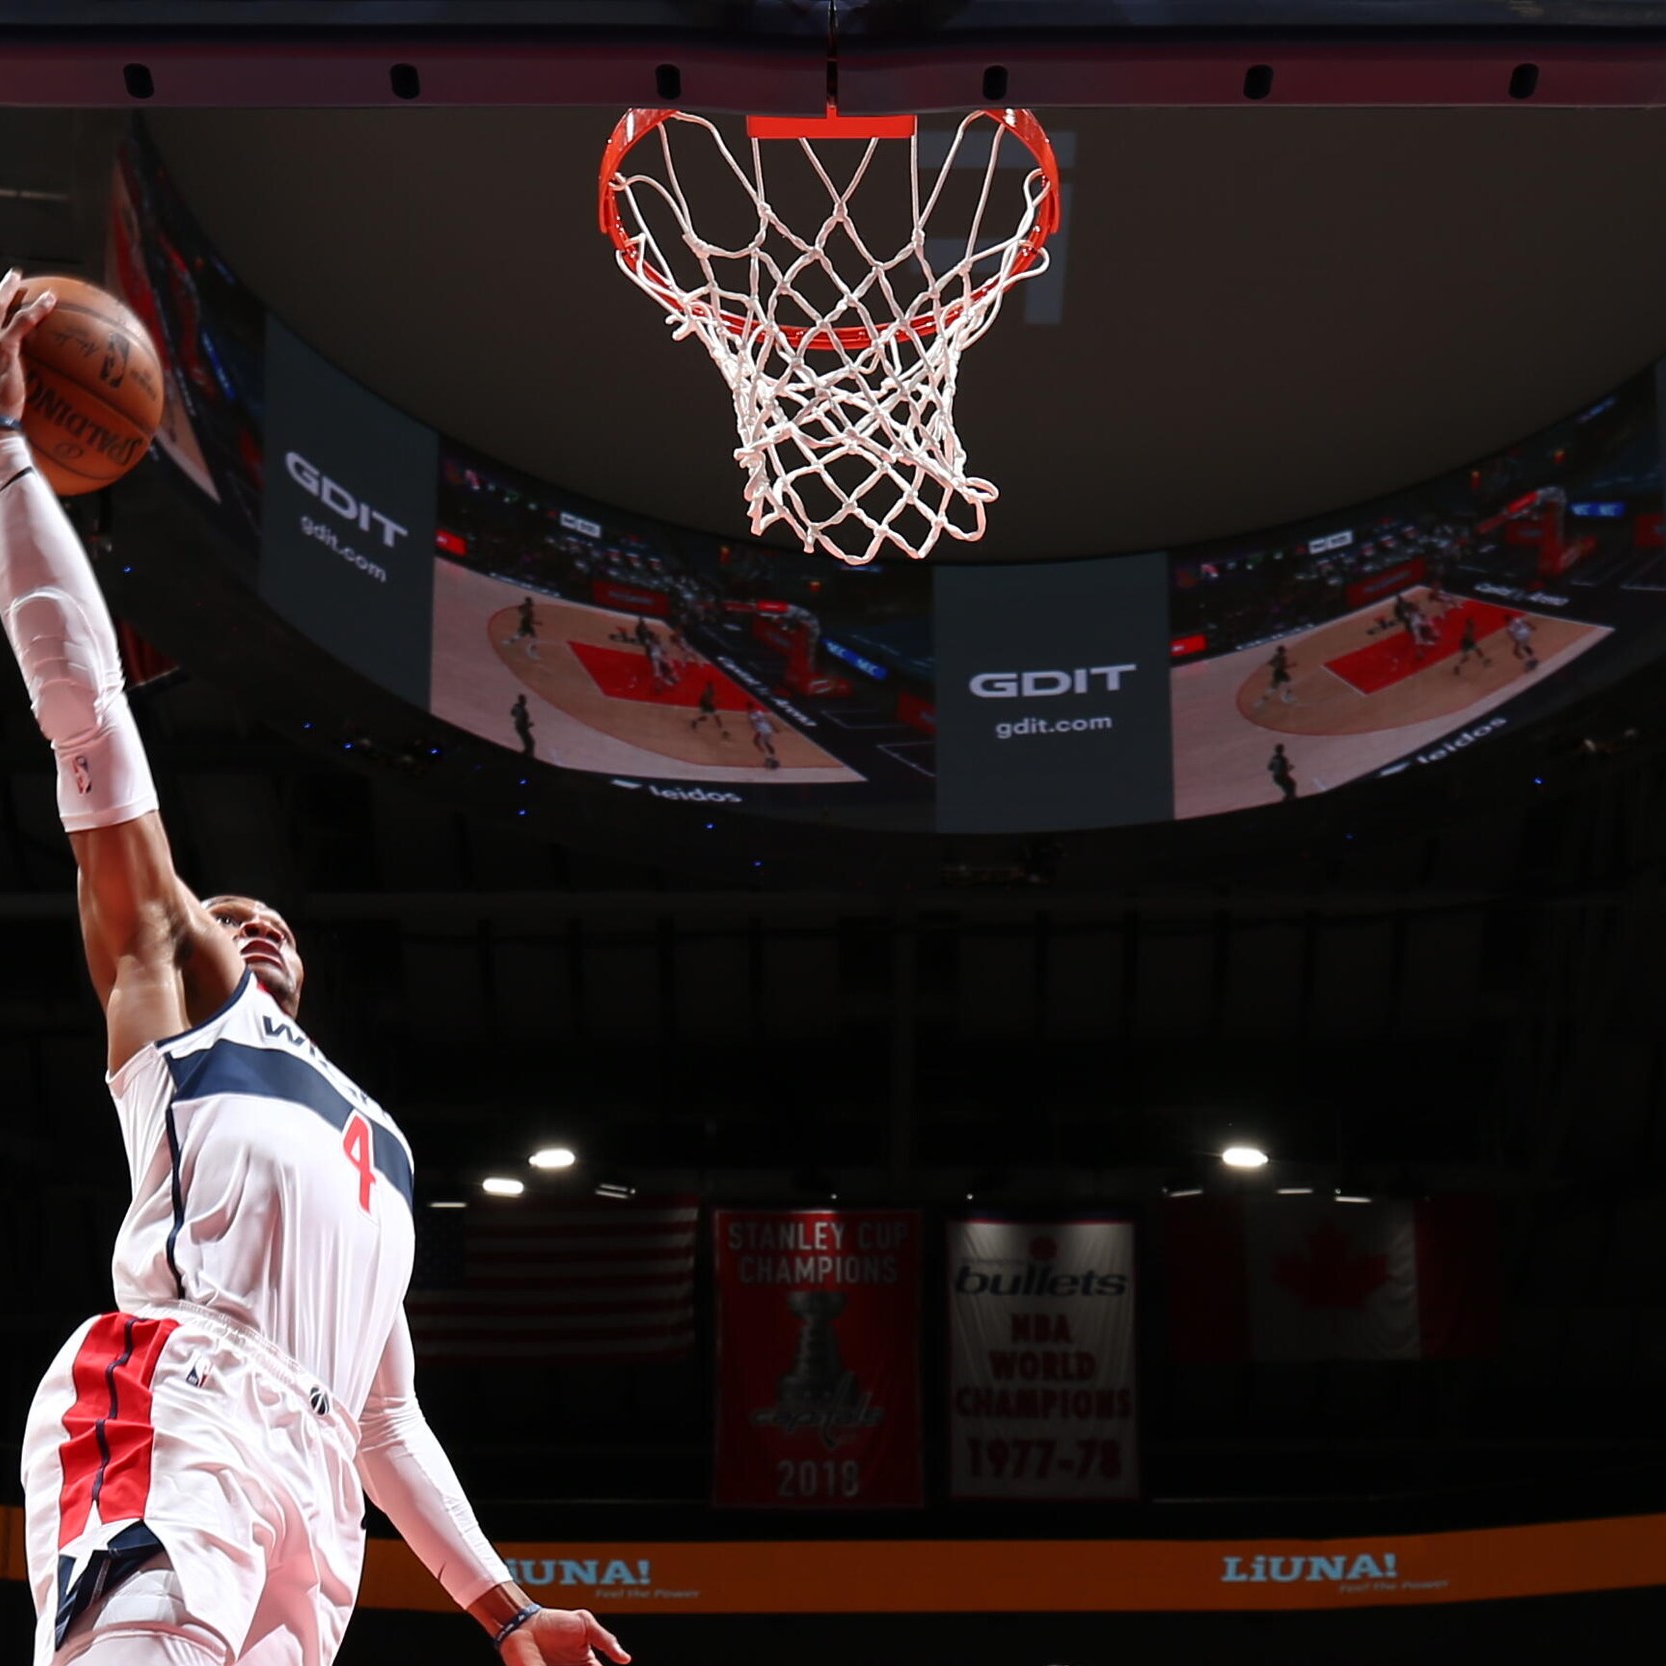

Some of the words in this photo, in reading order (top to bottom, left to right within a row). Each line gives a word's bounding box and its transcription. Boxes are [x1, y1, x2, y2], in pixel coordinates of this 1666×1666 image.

[284, 450, 409, 548] GDIT
[300, 515, 388, 584] gdit.com
[968, 664, 1137, 699] GDIT
[995, 713, 1114, 739] gdit.com
[648, 784, 742, 803] leidos
[341, 1113, 377, 1217] 4
[727, 1222, 846, 1252] STANLEY
[857, 1222, 910, 1251] CUP
[739, 1255, 899, 1284] CHAMPIONS
[955, 1263, 1127, 1297] bullets
[1010, 1313, 1072, 1344] NBA
[988, 1351, 1097, 1382] WORLD
[956, 1386, 1132, 1419] CHAMPIONS
[967, 1437, 1122, 1480] 1977-78
[776, 1459, 861, 1498] 2018
[505, 1557, 653, 1586] iUNA!
[1220, 1552, 1399, 1583] LiUNA!
